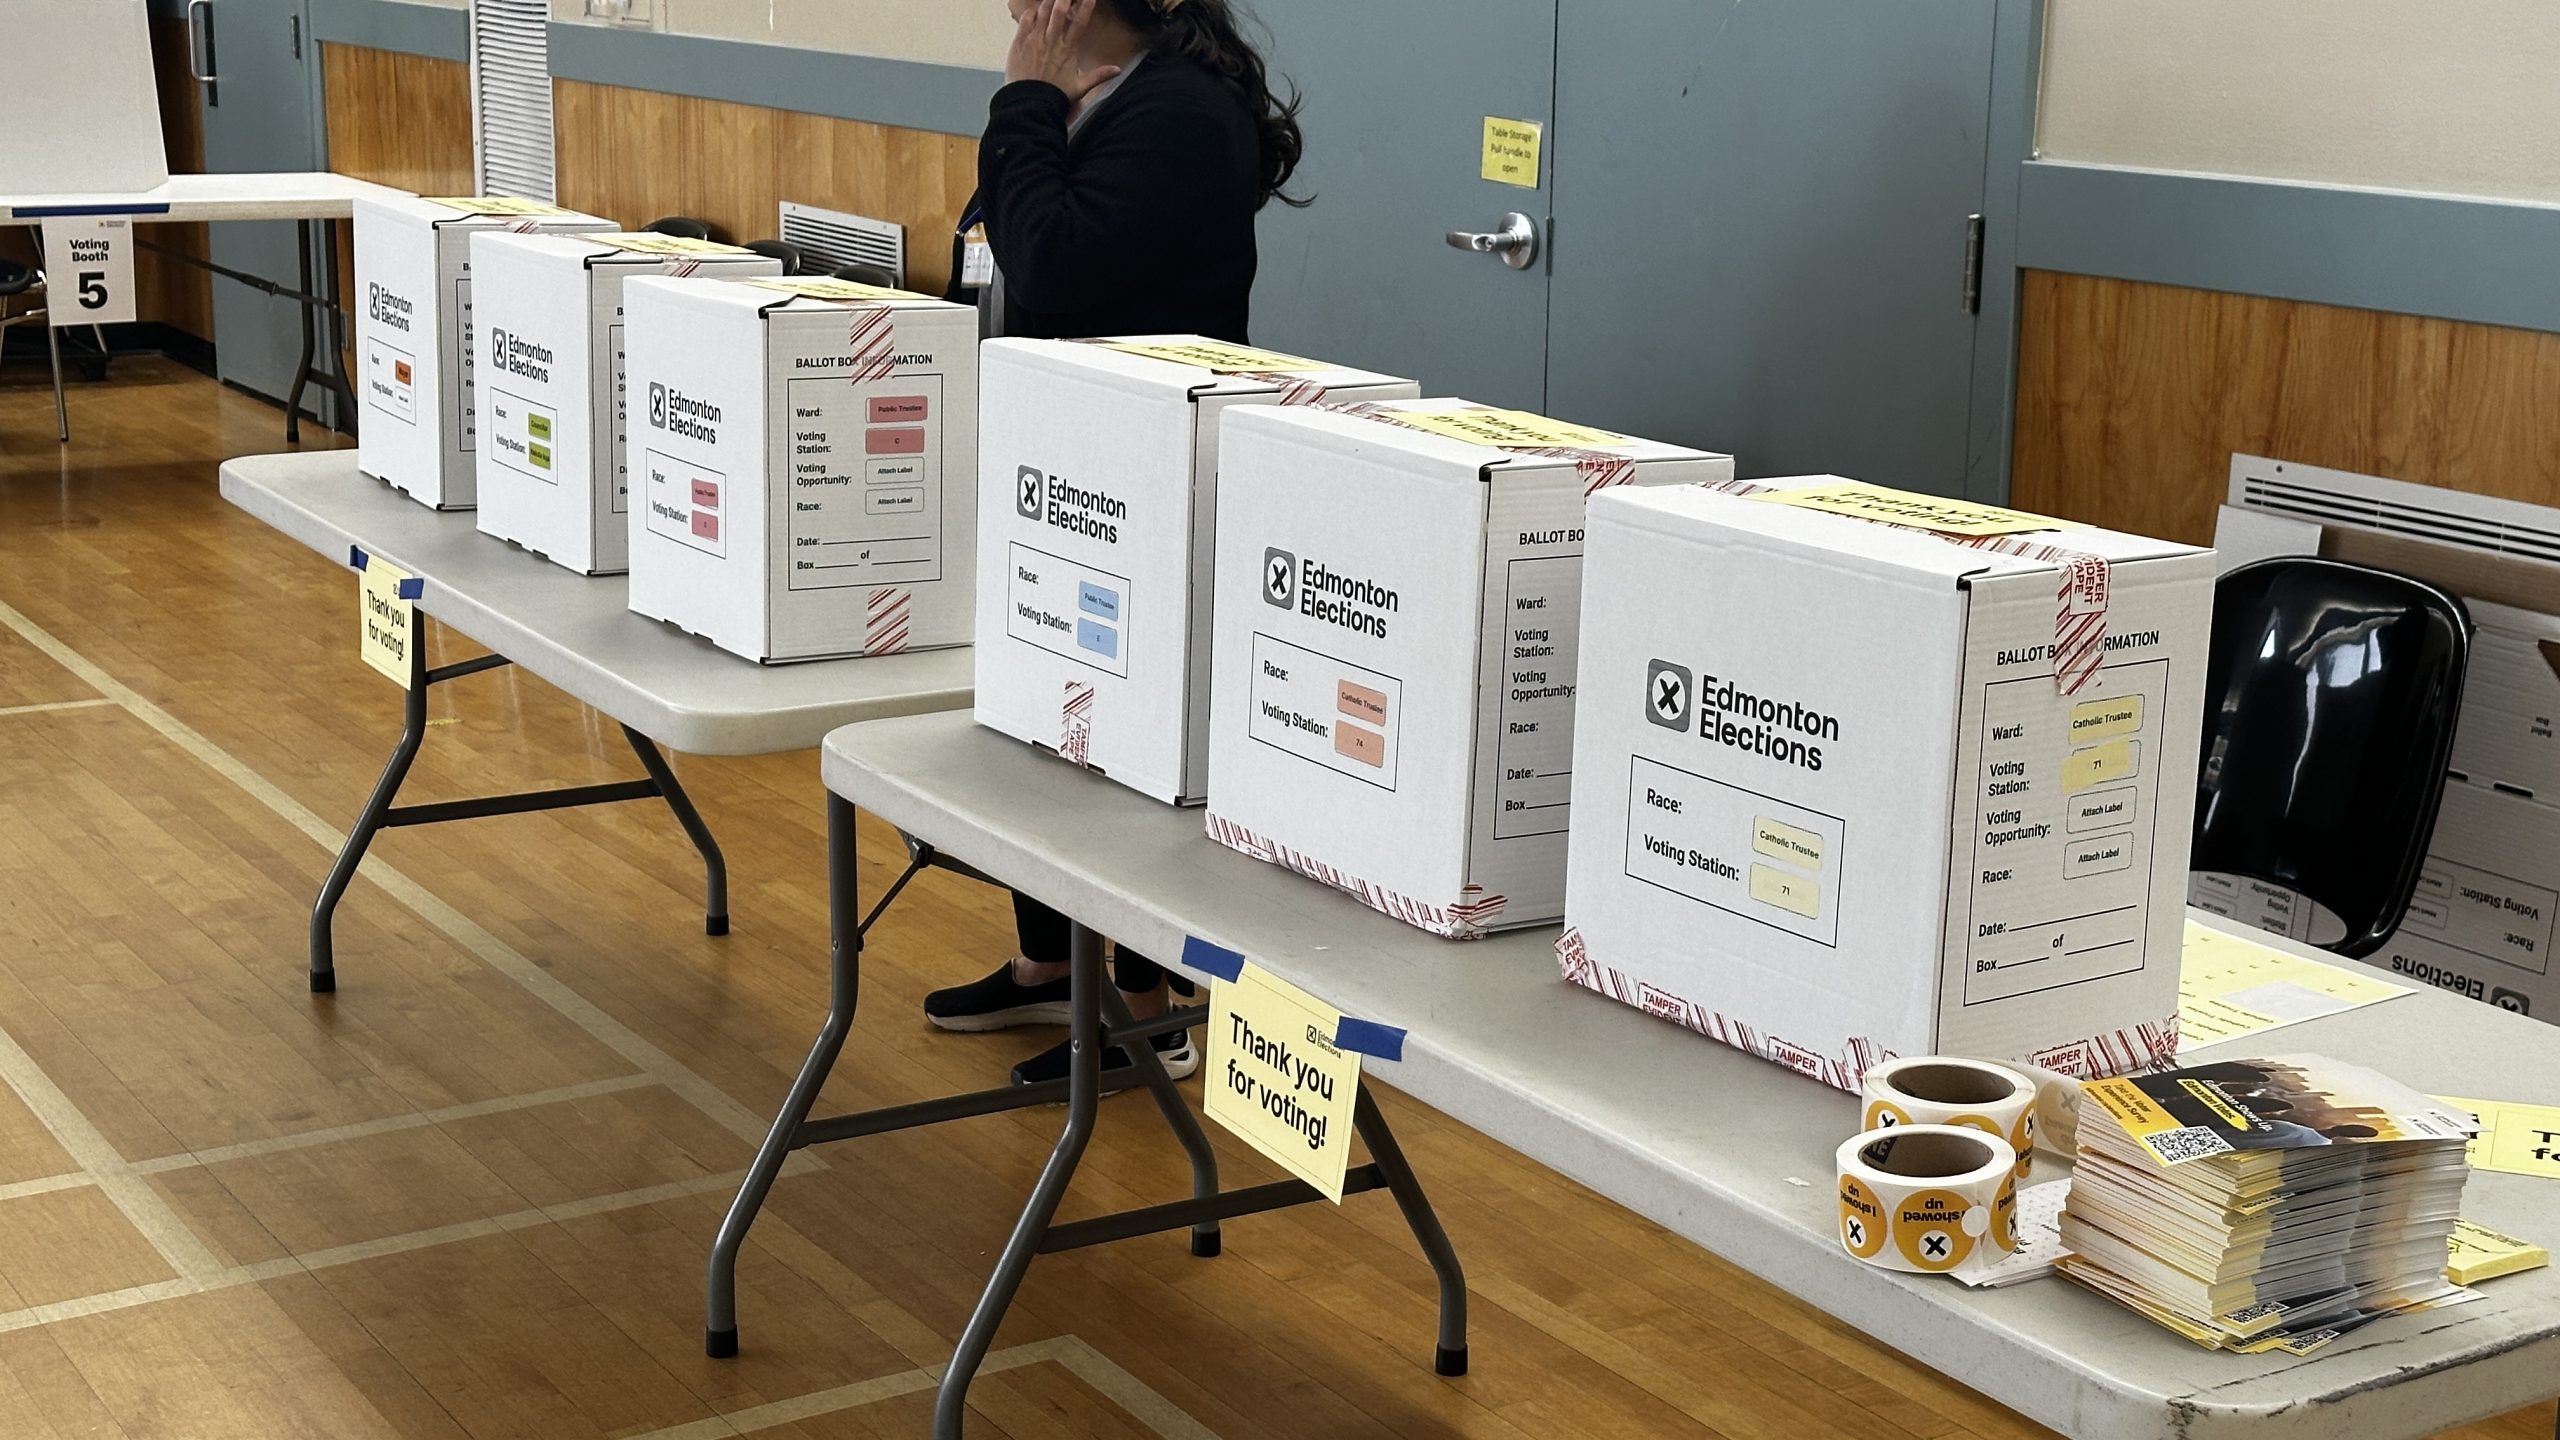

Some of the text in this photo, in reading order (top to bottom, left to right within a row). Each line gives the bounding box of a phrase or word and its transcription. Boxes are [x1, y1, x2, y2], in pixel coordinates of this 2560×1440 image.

[69, 238, 110, 251] Voting
[72, 251, 109, 262] Booth
[78, 271, 109, 310] 5
[381, 287, 413, 316] Edmonton
[381, 305, 410, 332] Elections
[509, 333, 553, 364] Edmonton
[509, 354, 549, 383] Elections
[796, 357, 836, 368] BALLOT
[669, 389, 721, 424] Edmonton
[796, 408, 823, 418] Ward:
[669, 412, 716, 444] Elections
[796, 432, 826, 443] Voting
[796, 444, 831, 454] Station:
[796, 464, 826, 474] Voting
[796, 476, 852, 487] Opportunity:
[796, 503, 822, 511] Race:
[1049, 475, 1126, 520] Edmonton
[1840, 491, 1940, 510] Thank
[1945, 509, 2013, 523] you
[652, 500, 688, 524] Voting Station:
[1803, 495, 1859, 504] for
[1861, 504, 1982, 525] voting!
[1048, 502, 1117, 544] Elections
[797, 537, 820, 547] Date:
[1519, 529, 1585, 545] BALLOT BO
[797, 550, 870, 570] Box of
[1018, 566, 1039, 585] Race:
[2084, 562, 2095, 605] IDENT
[2094, 557, 2105, 603] MPER
[1302, 559, 1399, 612] Edmonton
[367, 589, 405, 628] Thank you
[1516, 597, 1546, 609] Ward:
[1017, 602, 1072, 633] Voting Station:
[1301, 588, 1386, 639] Elections
[368, 618, 404, 661] for voting!
[1514, 629, 1548, 642] Voting
[1513, 645, 1554, 658] Station:
[1997, 646, 2045, 665] BALLOT
[1264, 660, 1289, 682] Race:
[1512, 671, 1546, 684] Voting
[1511, 685, 1576, 702] Opportunity:
[1702, 675, 1840, 742] Edmonton
[1262, 700, 1328, 738] Voting Station:
[1510, 722, 1538, 734] Race:
[2073, 711, 2133, 729] Catholic Trustee
[1700, 708, 1822, 771] Elections
[1992, 724, 2023, 740] Ward:
[1355, 739, 1364, 748] 74
[1507, 768, 1534, 780] Date:
[1990, 761, 2025, 777] Voting
[2093, 760, 2102, 770] 71
[1988, 780, 2030, 796] Station:
[1505, 800, 1525, 812] Box
[1646, 788, 1682, 814] Race:
[2081, 802, 2123, 817] Attach Label
[1986, 809, 2021, 825] Voting
[1985, 823, 2051, 847] Opportunity:
[1759, 830, 1819, 860] Catholic Trustee
[1644, 834, 1740, 882] Voting Station:
[2078, 848, 2120, 863] Attach Label
[1982, 868, 2012, 884] Race:
[1782, 885, 1790, 895] 71
[2460, 887, 2539, 920] Voting Station:
[1979, 922, 2007, 937] Date:
[2504, 932, 2534, 952] Race:
[1976, 933, 2064, 973] Box of
[2392, 955, 2485, 1001] Elections
[1644, 991, 1681, 1016] TAMPER
[1230, 1012, 1334, 1102] Thank you
[1774, 1046, 1816, 1072] TAMPER
[2039, 1049, 2081, 1068] TAMPER
[1227, 1058, 1327, 1150] for voting!
[2201, 1080, 2239, 1105] Edmonton
[2235, 1104, 2262, 1122] Shows
[1847, 1184, 1860, 1197] up
[1925, 1198, 1943, 1210] up
[1903, 1211, 1960, 1223] showed
